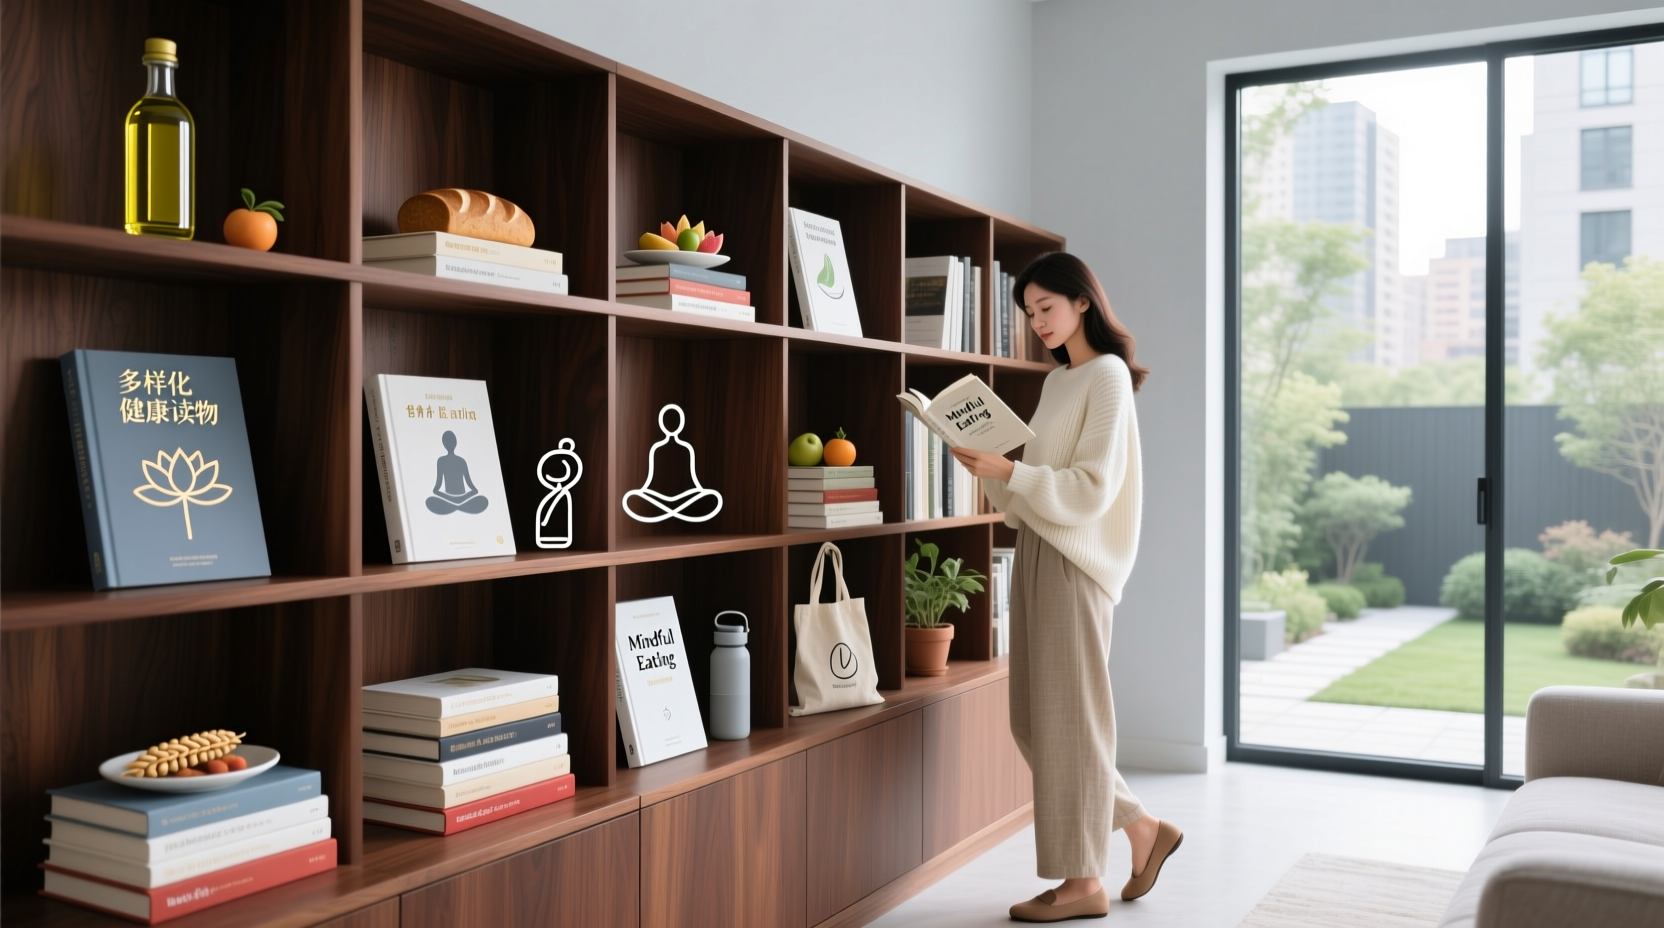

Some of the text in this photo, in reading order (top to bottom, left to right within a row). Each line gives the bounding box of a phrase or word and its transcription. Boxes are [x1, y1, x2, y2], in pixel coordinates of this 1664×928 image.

[118, 368, 193, 397] 多样化
[119, 396, 218, 426] 健康读物
[628, 628, 675, 651] Mindful
[636, 651, 677, 672] Eating
